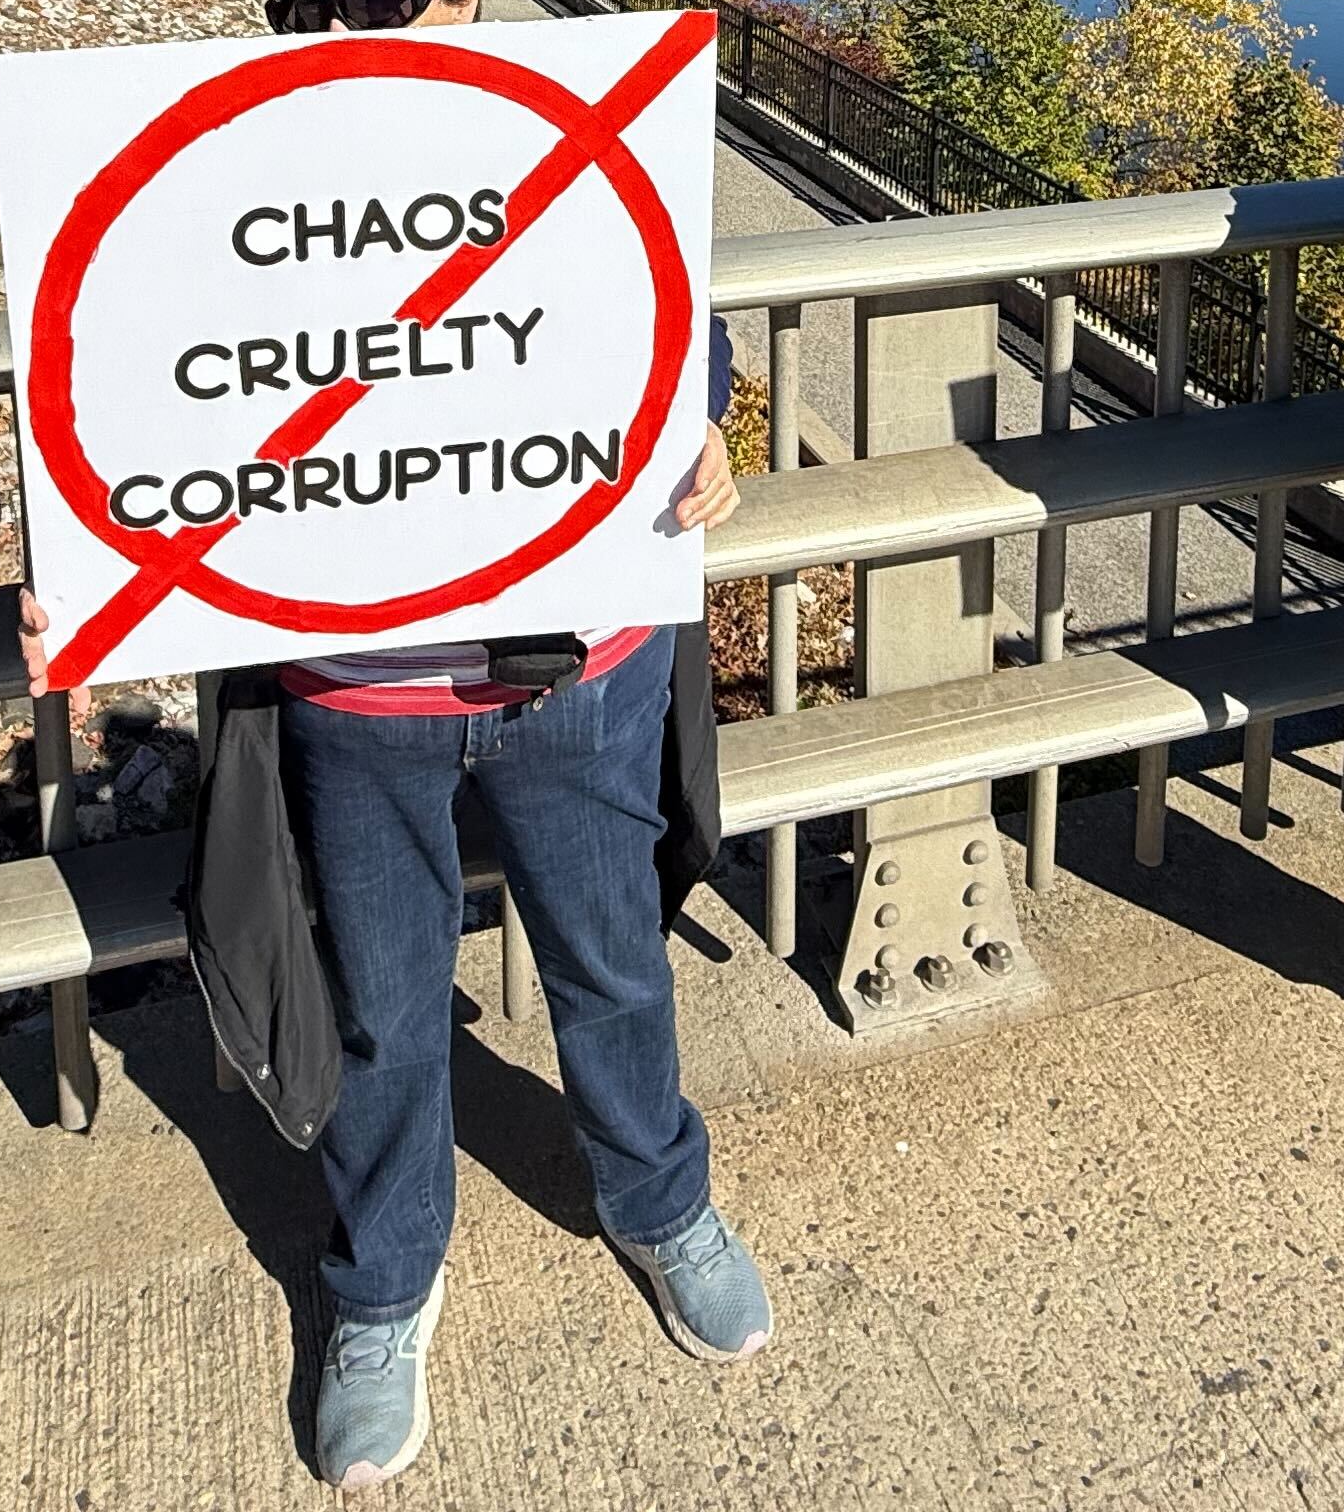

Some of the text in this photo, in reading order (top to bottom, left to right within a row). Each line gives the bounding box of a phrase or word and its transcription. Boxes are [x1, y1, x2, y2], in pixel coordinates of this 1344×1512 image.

[231, 188, 506, 267] CHAOS
[174, 307, 545, 400] CRUELTY
[109, 428, 621, 529] CORRUPTION
